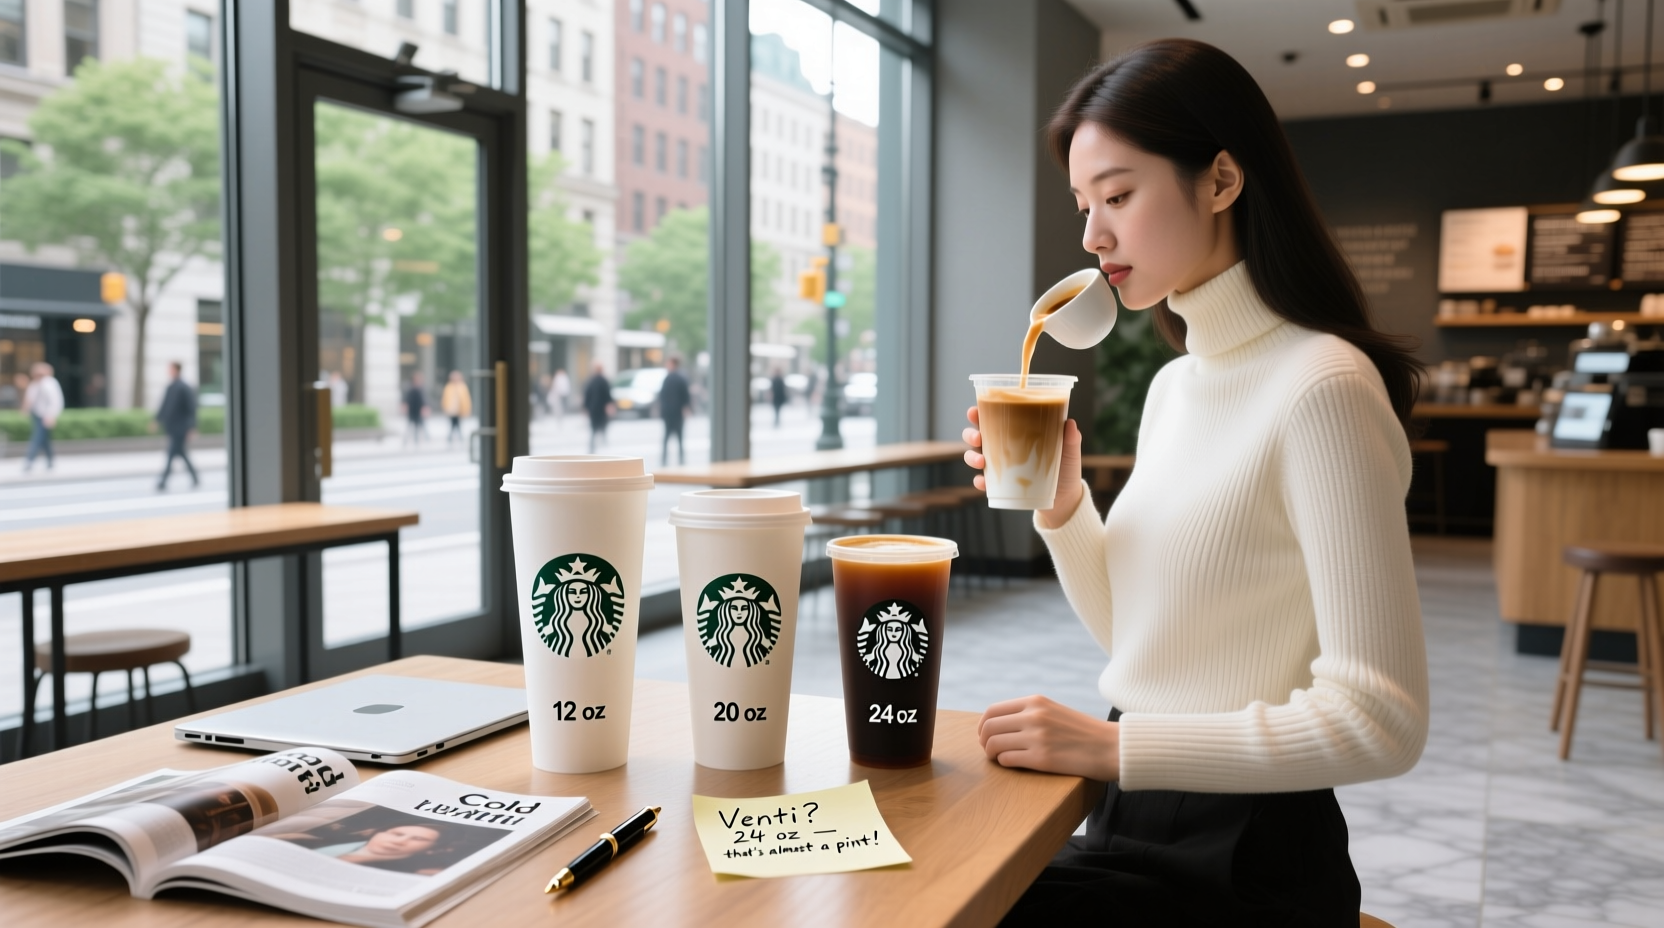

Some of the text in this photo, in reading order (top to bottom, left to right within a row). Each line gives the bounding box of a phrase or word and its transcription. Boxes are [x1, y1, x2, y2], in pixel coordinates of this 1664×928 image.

[552, 700, 606, 721] 12 oz
[713, 701, 767, 722] 20 oz
[868, 703, 918, 724] 24 oz
[458, 793, 541, 814] Cold
[718, 802, 819, 829] Venti?
[723, 846, 764, 859] that's
[836, 830, 879, 854] pint!
[733, 829, 766, 844] 24
[775, 831, 801, 840] oz
